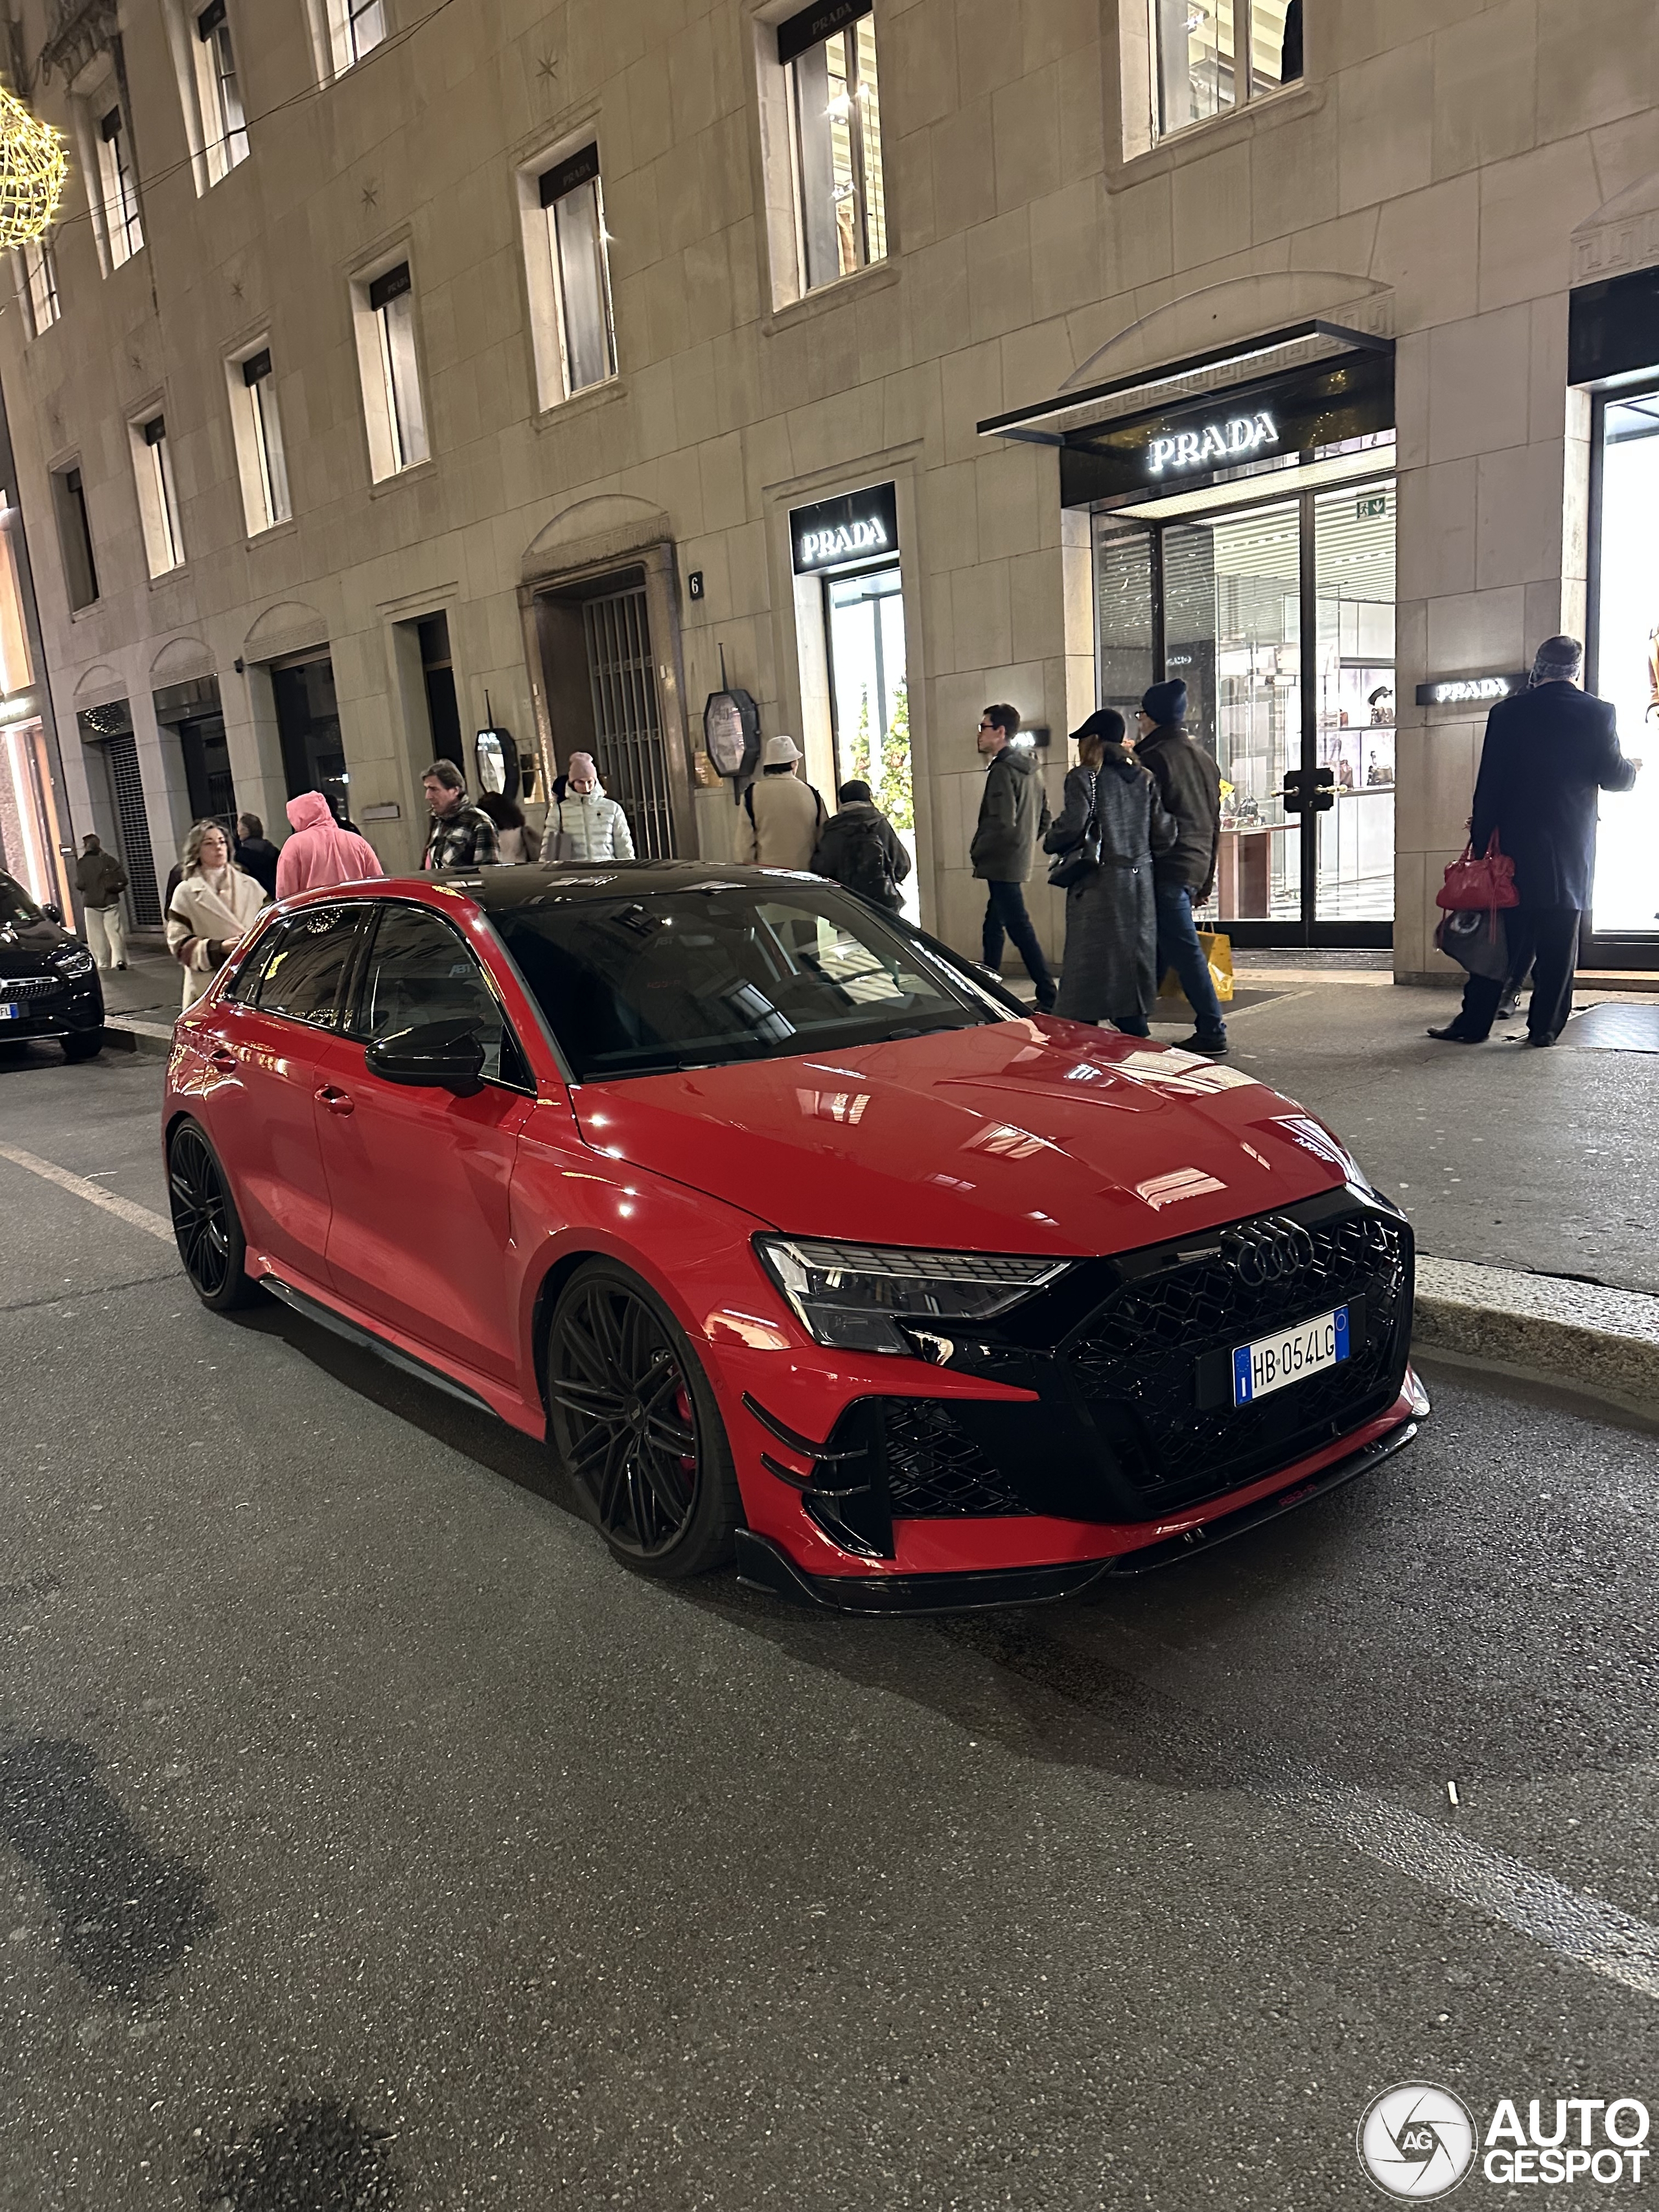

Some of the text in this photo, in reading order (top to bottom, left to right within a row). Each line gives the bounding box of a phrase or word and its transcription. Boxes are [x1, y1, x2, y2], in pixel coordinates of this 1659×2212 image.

[812, 3, 852, 35] PRADA
[1148, 413, 1279, 472] PRADA
[802, 518, 887, 561] PRADA
[691, 577, 699, 594] 6
[1436, 678, 1509, 703] PRADA
[448, 964, 471, 977] ABT
[1279, 1484, 1317, 1506] RS3-R
